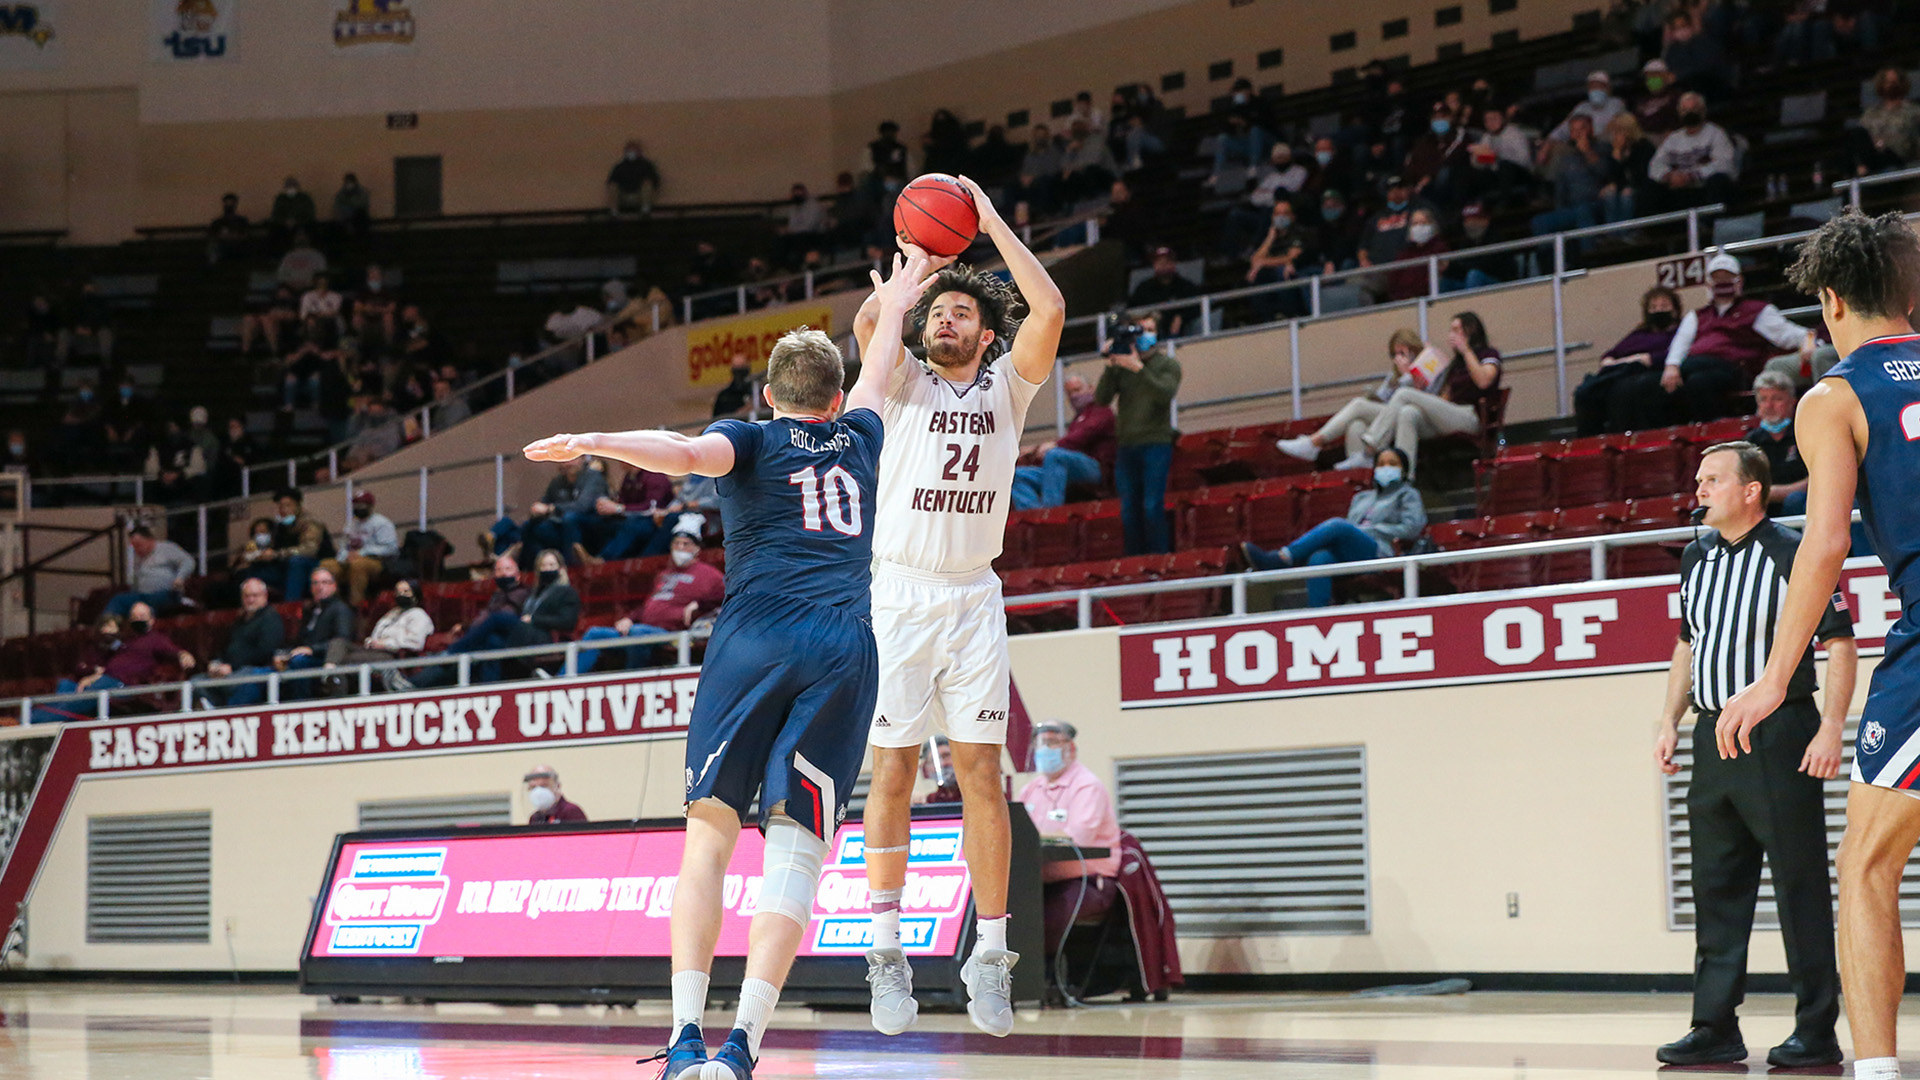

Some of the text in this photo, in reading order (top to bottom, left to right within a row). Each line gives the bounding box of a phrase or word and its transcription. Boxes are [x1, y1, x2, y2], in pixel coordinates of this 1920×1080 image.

[337, 20, 413, 38] TECH
[1660, 258, 1703, 288] 214
[690, 332, 759, 380] golden
[1883, 360, 1920, 381] SHE
[929, 411, 995, 435] EASTERN
[942, 443, 980, 482] 24
[788, 464, 863, 537] 10
[911, 488, 996, 514] KENTUCKY
[1153, 598, 1618, 692] HOME OF
[977, 709, 1005, 722] EKU
[88, 716, 260, 770] EASTERN
[271, 694, 502, 756] KENTUCKY
